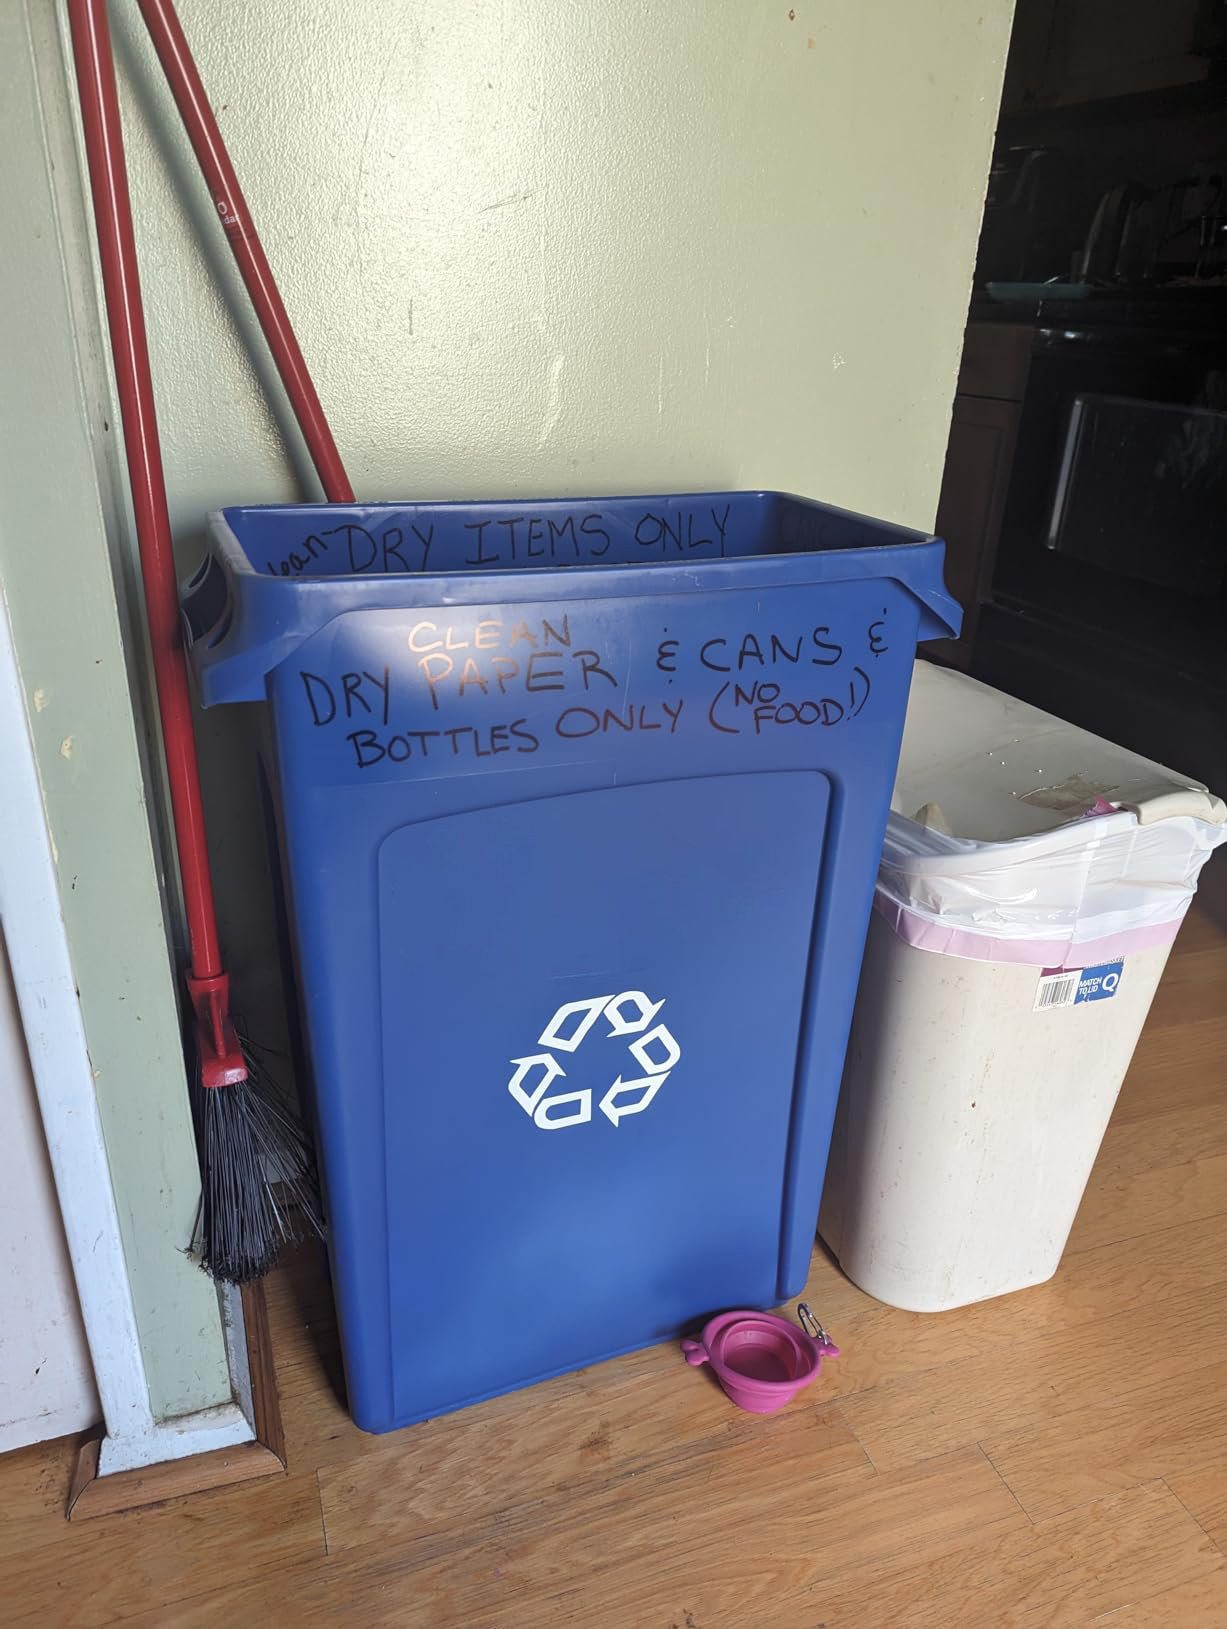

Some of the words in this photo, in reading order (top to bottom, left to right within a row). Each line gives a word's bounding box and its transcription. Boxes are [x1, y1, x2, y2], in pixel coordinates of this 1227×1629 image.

[322, 524, 434, 574] DRY
[464, 513, 611, 566] ITEMS
[634, 503, 731, 558] ONLY
[407, 613, 572, 653] CLEAN
[300, 664, 391, 727] DRY
[416, 648, 618, 711] PAPER
[700, 626, 843, 673] CANS
[346, 718, 540, 769] BOTTLES
[555, 699, 684, 738] ONLY
[1101, 972, 1120, 992] Q
